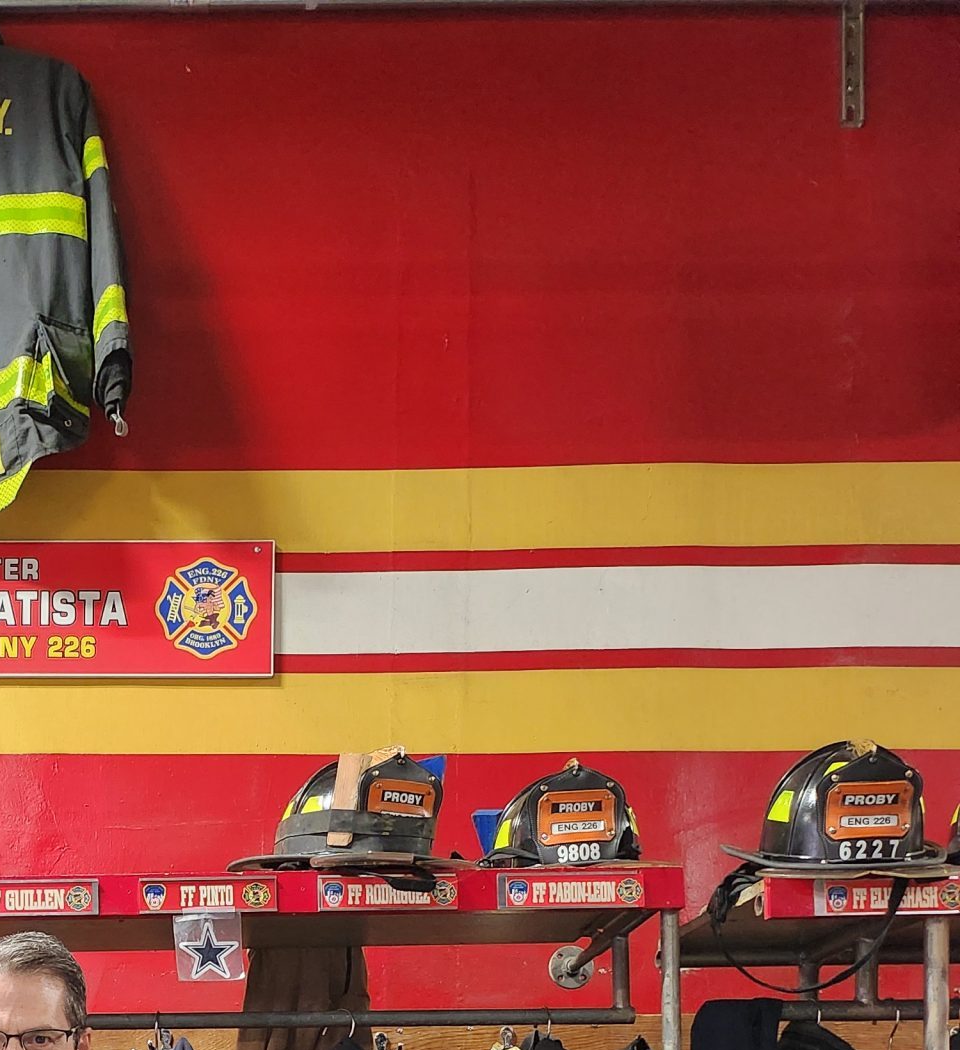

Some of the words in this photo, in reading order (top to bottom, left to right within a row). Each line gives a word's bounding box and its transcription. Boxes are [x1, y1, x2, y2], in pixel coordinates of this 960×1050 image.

[192, 576, 221, 585] FDNY
[47, 635, 97, 659] 226
[184, 638, 227, 648] BROOKLYN
[383, 790, 423, 806] PROBY
[558, 801, 596, 813] PROBY
[844, 793, 897, 806] PROBY
[557, 822, 579, 832] ENG
[581, 821, 598, 831] 226
[847, 816, 870, 826] ENG
[873, 816, 891, 825] 226
[557, 843, 601, 863] 9808
[839, 839, 900, 861] 6227
[5, 888, 66, 911] GUILLEN
[180, 885, 196, 907] FF
[199, 884, 234, 907] PINTO
[347, 884, 362, 905] FF
[532, 882, 547, 903] FF
[548, 881, 616, 903] PABON-LEON
[852, 887, 868, 910] FF
